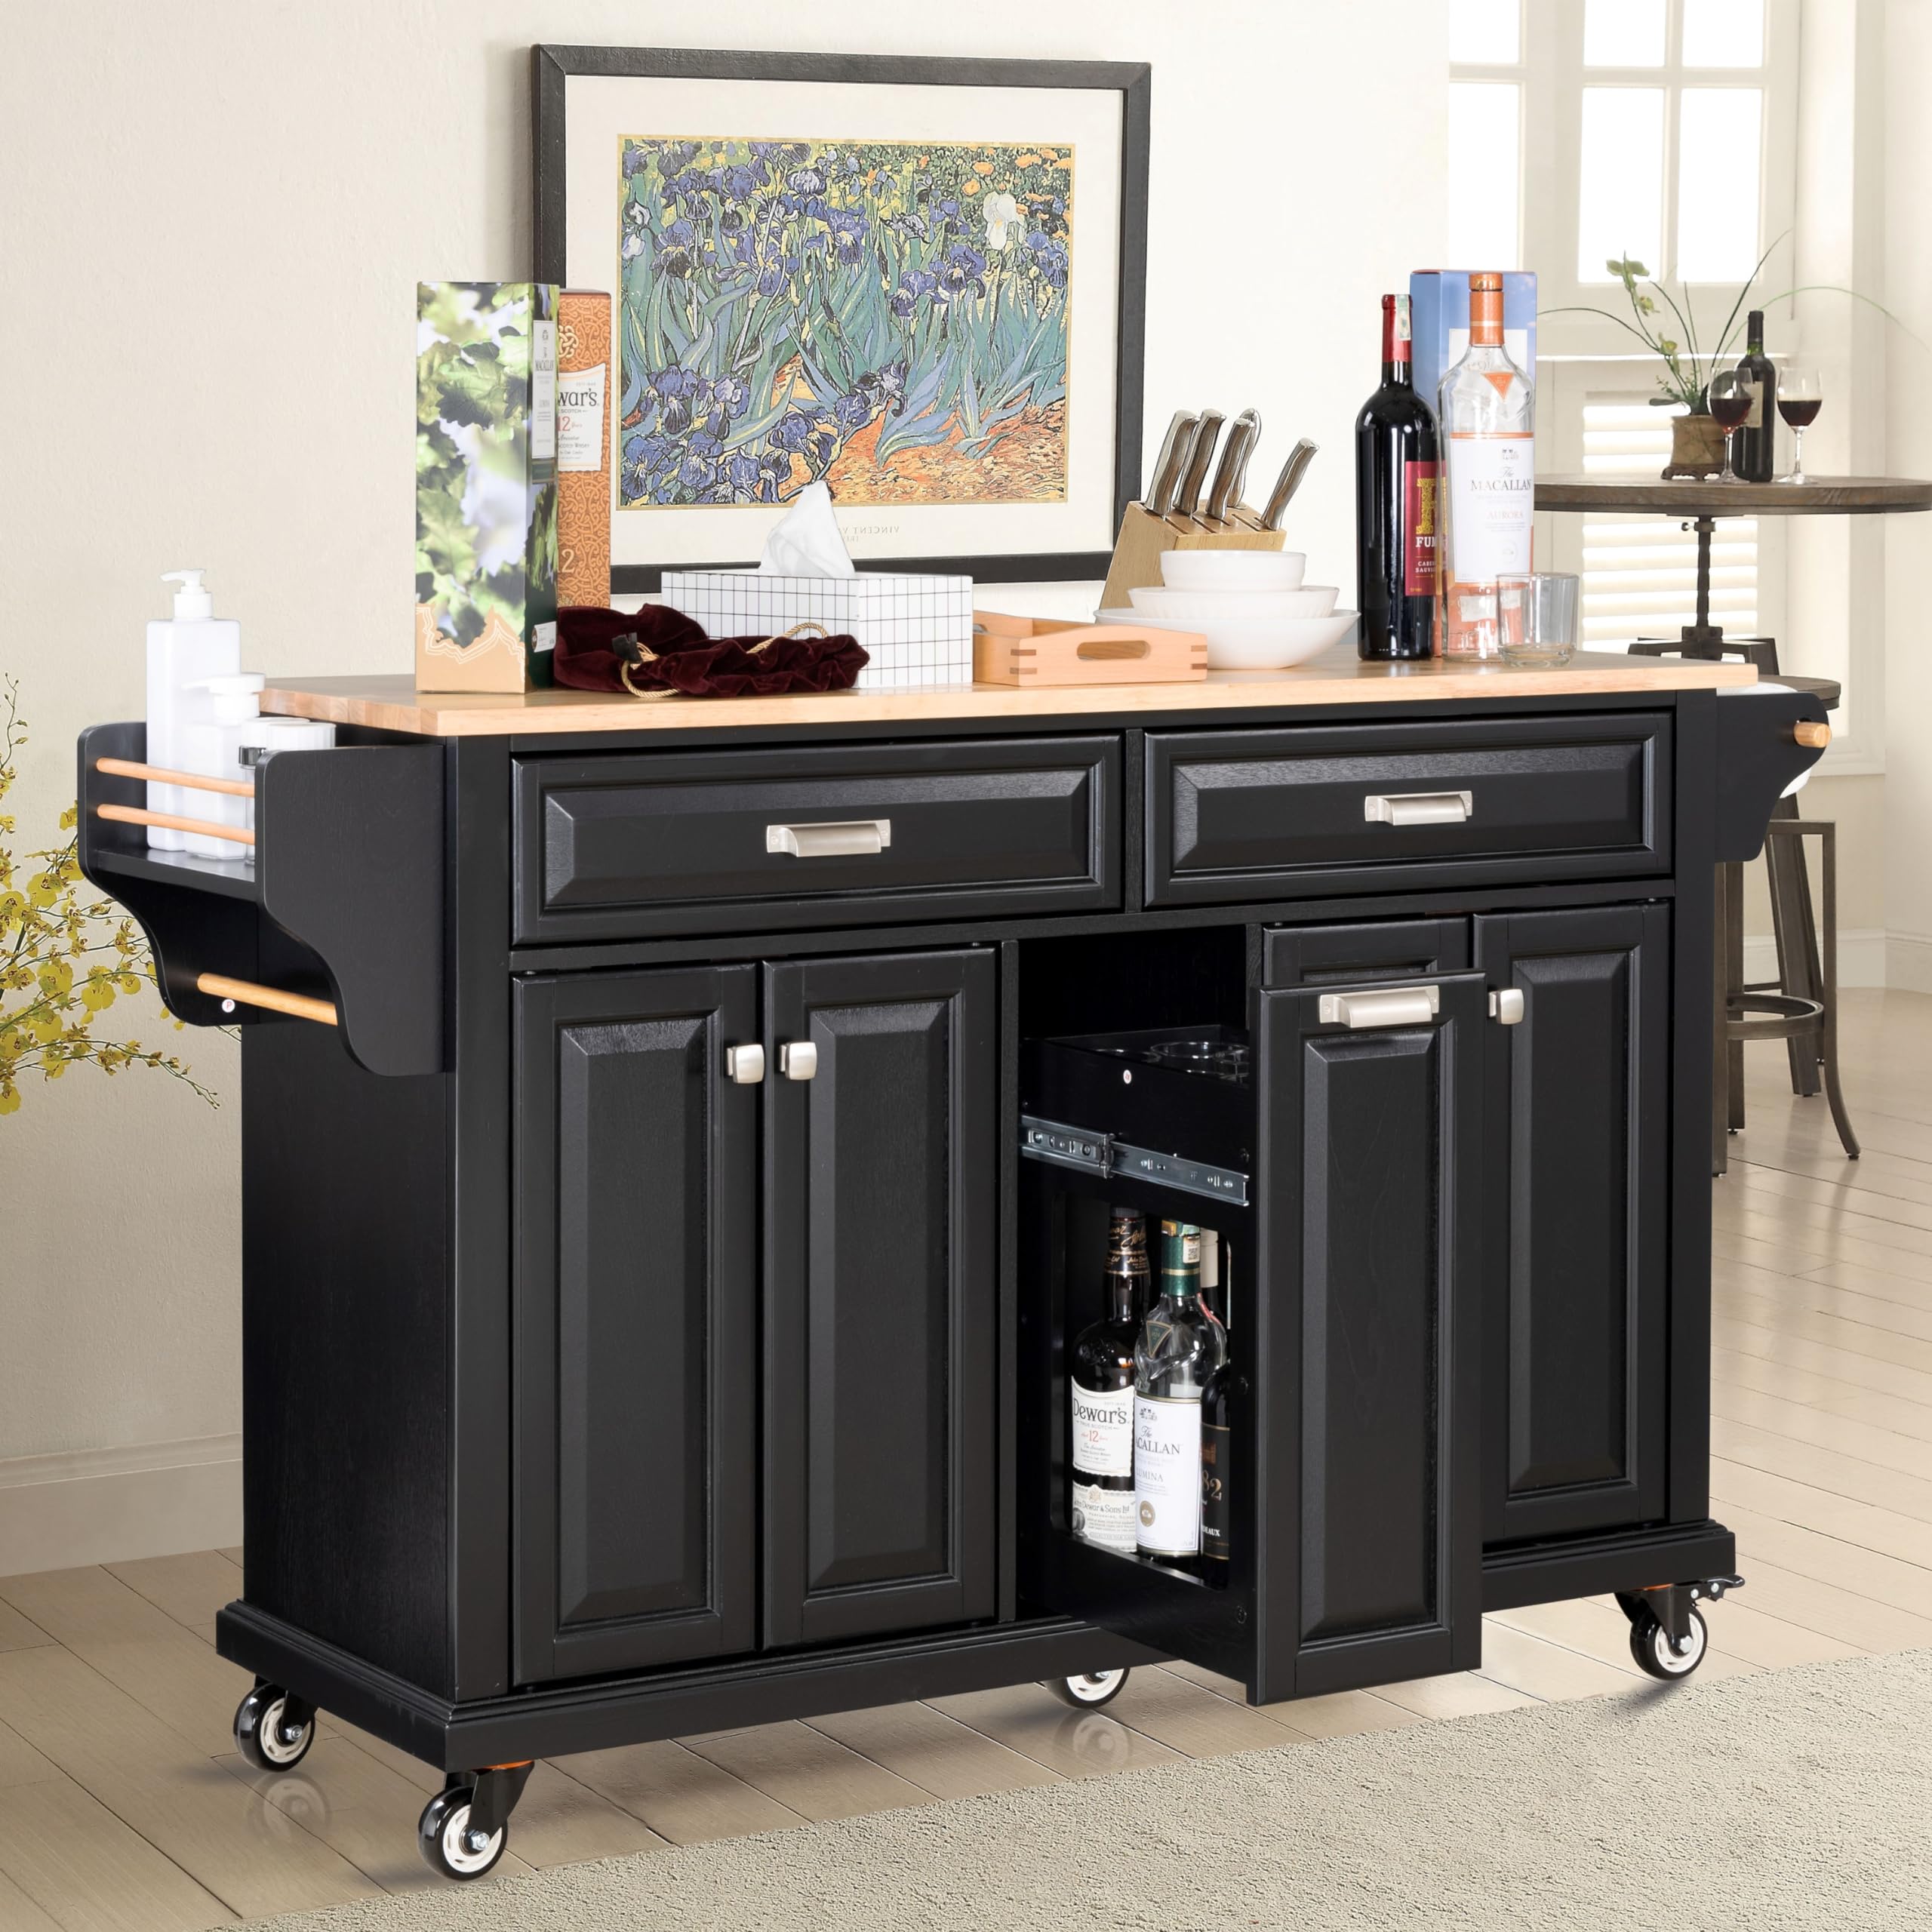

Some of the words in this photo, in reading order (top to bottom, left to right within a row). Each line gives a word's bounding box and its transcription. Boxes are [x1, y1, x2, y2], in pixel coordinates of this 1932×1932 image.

[557, 387, 598, 407] war's
[1470, 478, 1532, 491] MACALLAN
[1073, 1398, 1127, 1424] Dewar's
[1089, 1429, 1099, 1443] 12
[1140, 1426, 1152, 1438] The
[1136, 1436, 1180, 1454] ACALLAN
[1201, 1469, 1222, 1501] 82
[1202, 1525, 1221, 1537] DEAUX
